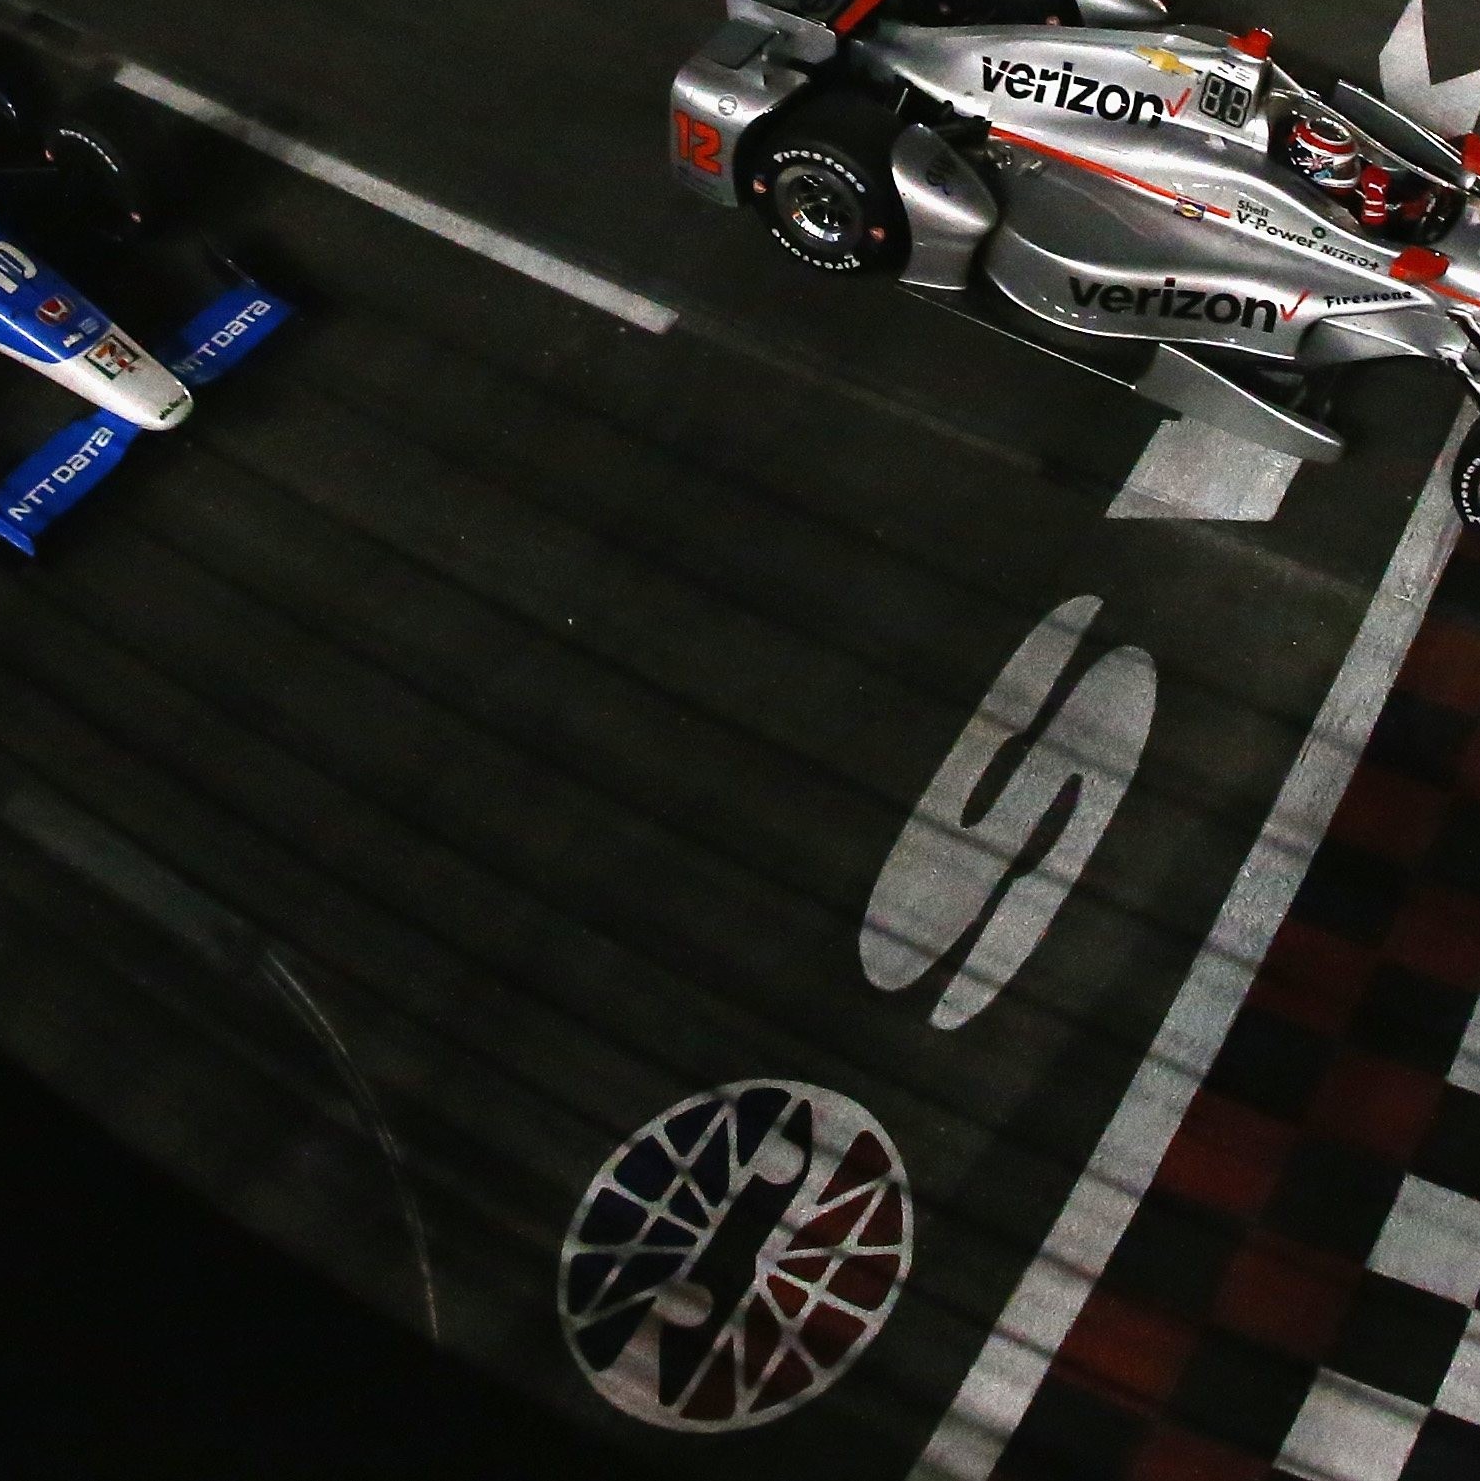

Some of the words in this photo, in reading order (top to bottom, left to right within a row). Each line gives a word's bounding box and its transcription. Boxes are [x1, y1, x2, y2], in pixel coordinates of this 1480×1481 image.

[981, 54, 1165, 129] verizon
[673, 109, 722, 176] 12
[772, 149, 867, 193] Firestone
[1237, 199, 1270, 217] Shell
[1237, 209, 1317, 250] V-Power
[771, 228, 861, 271] Firestone
[1068, 275, 1278, 334] verizon
[1323, 289, 1414, 308] Firestone
[211, 299, 272, 348] DATA
[7, 476, 57, 522] NTT
[50, 426, 114, 482] DATA
